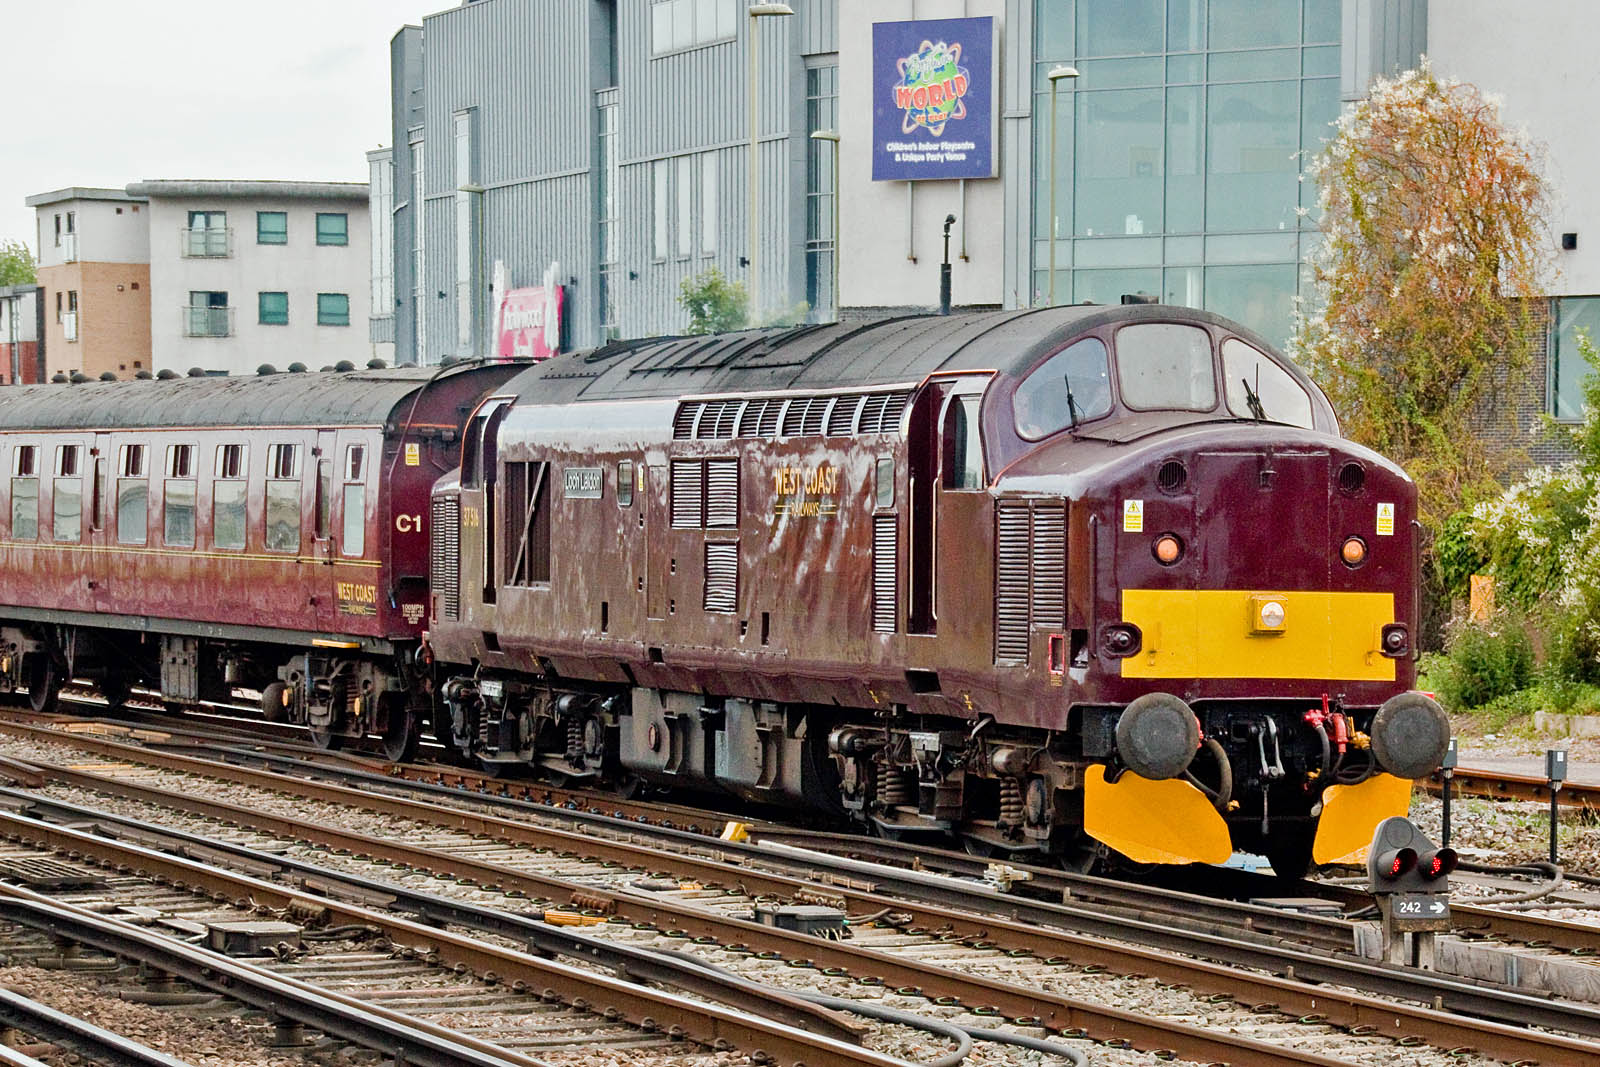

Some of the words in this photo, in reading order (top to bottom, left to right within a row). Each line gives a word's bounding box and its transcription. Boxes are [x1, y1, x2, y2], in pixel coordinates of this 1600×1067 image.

[896, 75, 967, 110] WORLD
[774, 467, 801, 495] WEST
[804, 467, 837, 495] COAST
[396, 513, 421, 533] C1
[337, 583, 354, 601] WEST
[355, 584, 376, 603] COAST
[1399, 902, 1421, 913] 242
